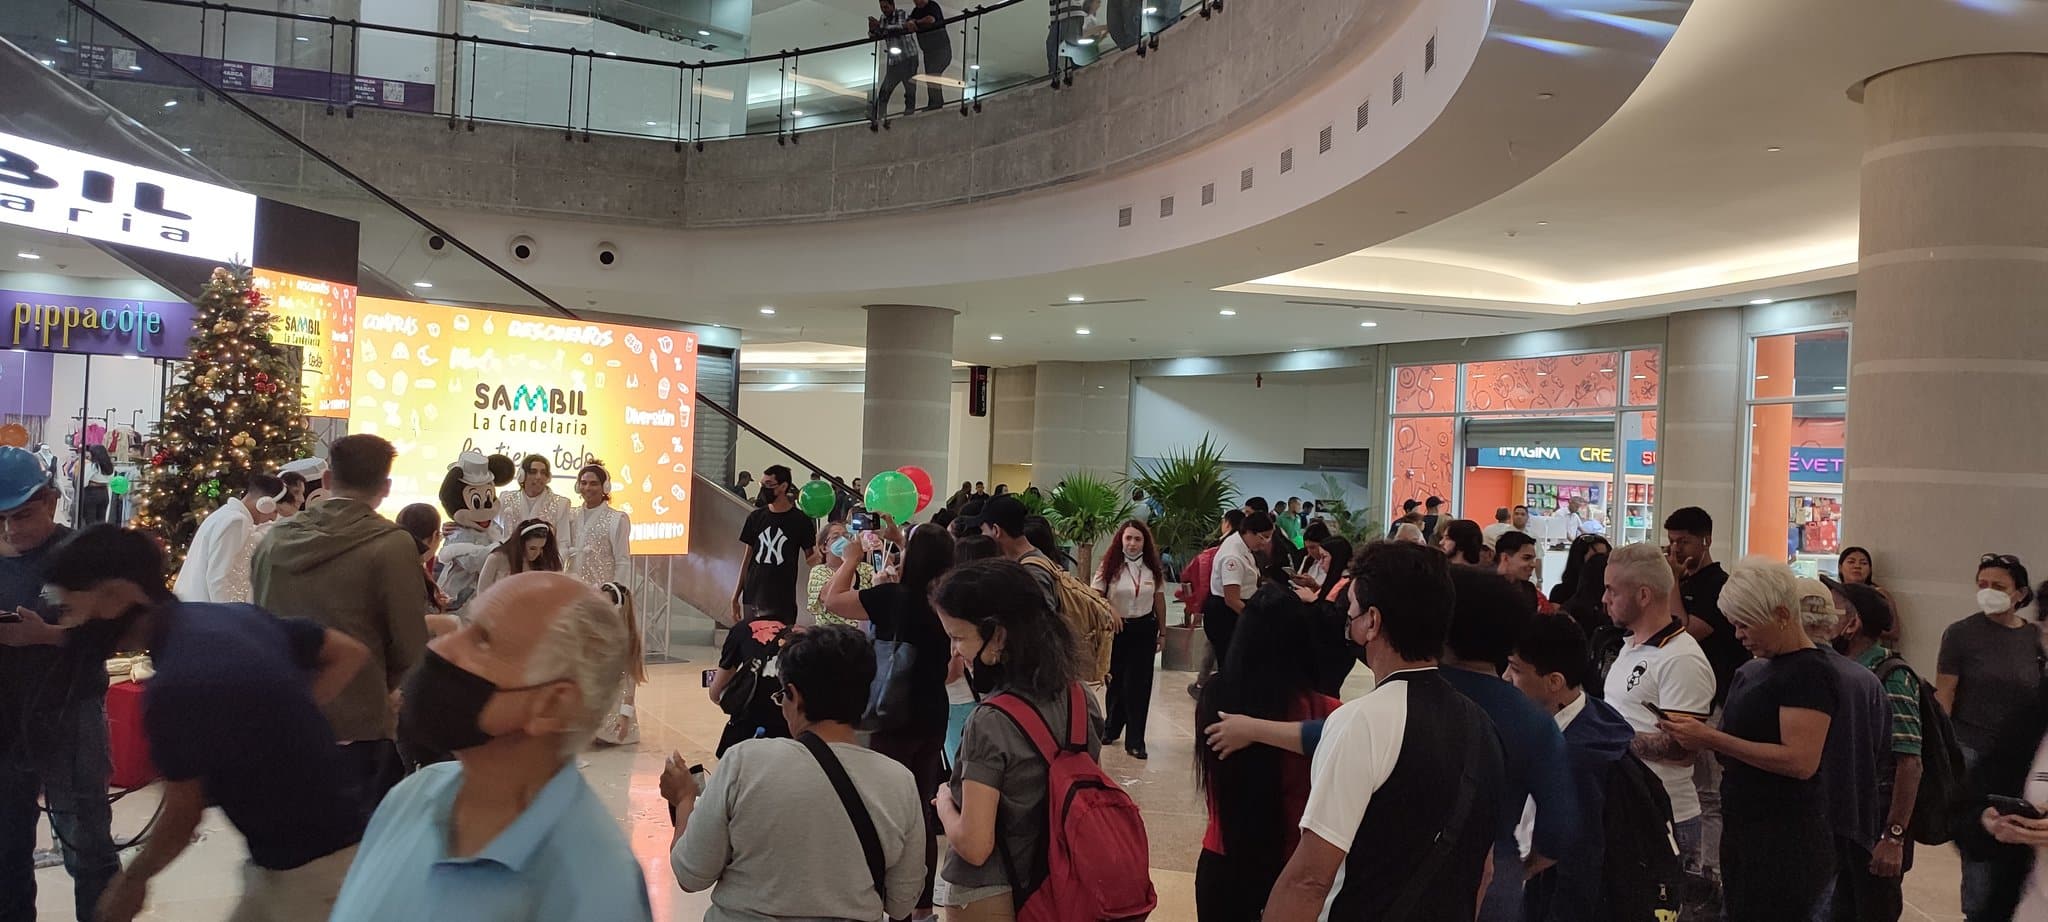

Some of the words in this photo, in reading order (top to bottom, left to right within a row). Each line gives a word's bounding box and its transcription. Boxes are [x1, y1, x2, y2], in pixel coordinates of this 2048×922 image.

[12, 301, 161, 352] pippacôte
[285, 316, 320, 336] SAMBIL
[474, 382, 588, 417] SAMBIL
[473, 412, 490, 430] La
[499, 414, 588, 436] Candelaria
[1498, 446, 1561, 460] IMAGINA
[1580, 447, 1615, 463] CRE
[755, 526, 788, 566] NY
